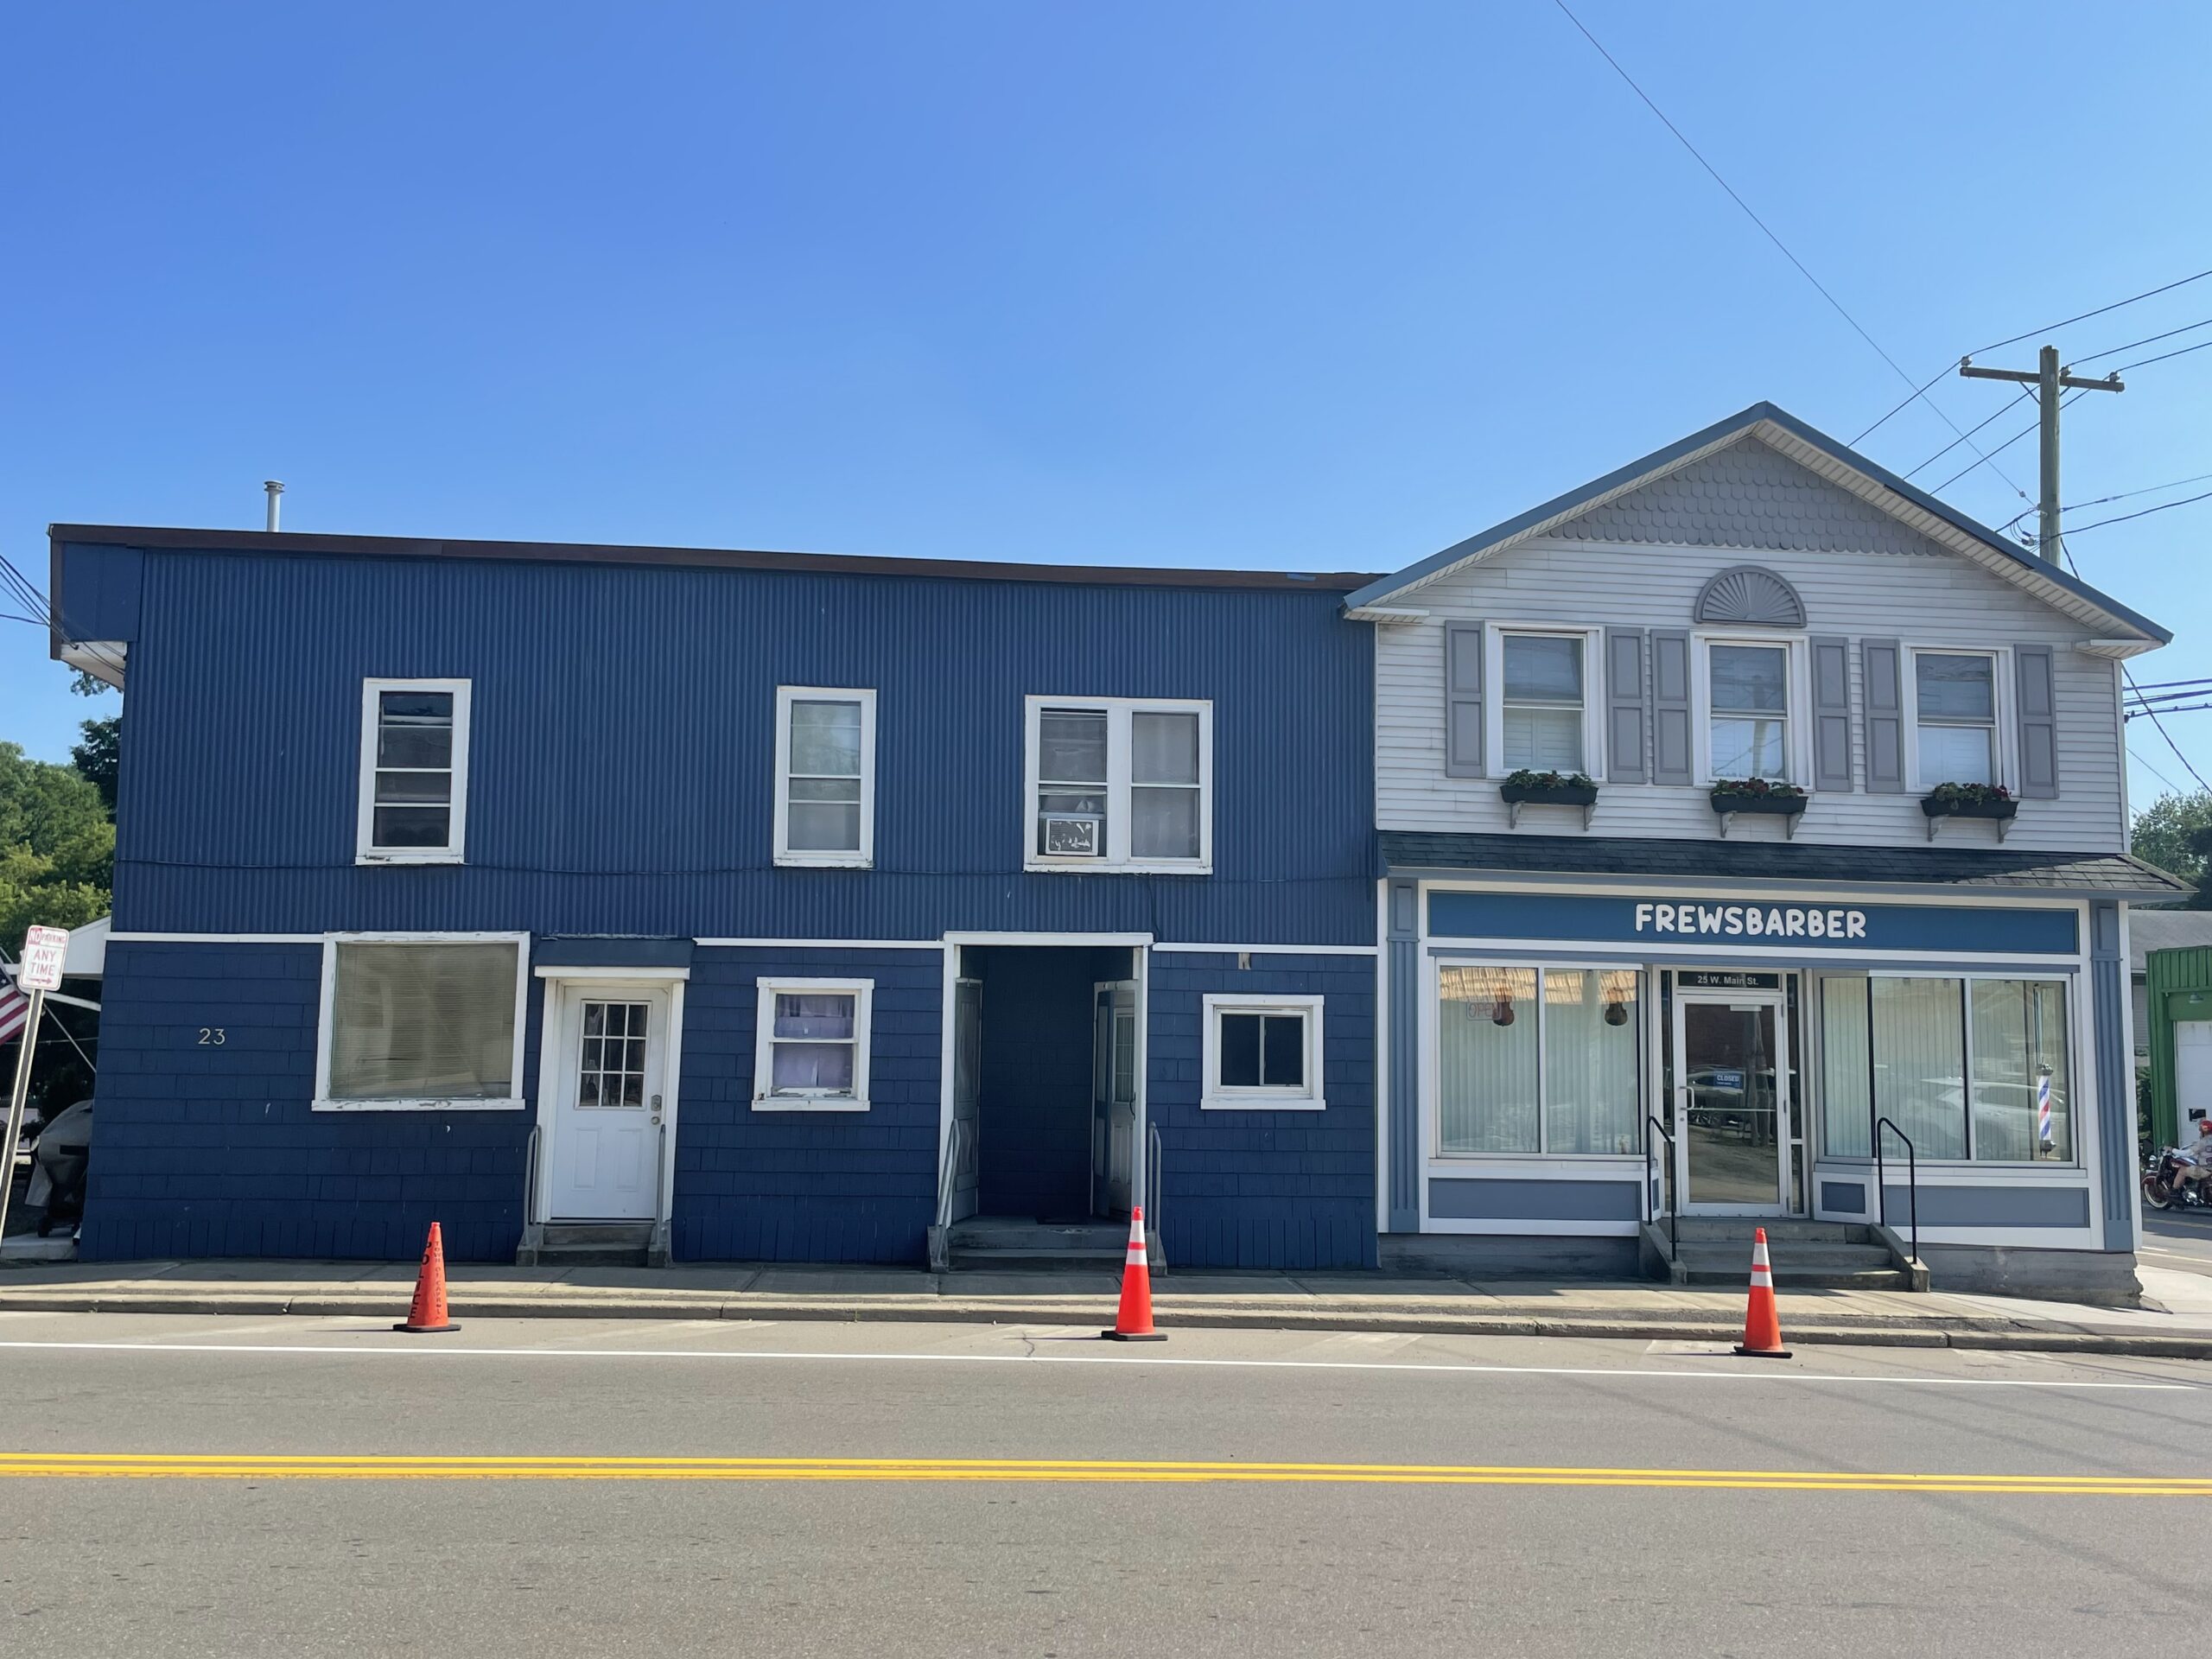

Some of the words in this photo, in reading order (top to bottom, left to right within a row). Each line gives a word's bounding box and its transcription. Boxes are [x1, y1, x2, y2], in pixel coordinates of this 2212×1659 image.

[1635, 903, 1866, 938] FREWSBARBER
[29, 930, 41, 943] NO
[41, 933, 66, 944] PARKING
[34, 950, 56, 962] ANY
[30, 962, 55, 976] TIME
[1697, 975, 1708, 984] 25
[1710, 976, 1721, 985] W.
[1724, 976, 1745, 986] Main
[1747, 976, 1759, 986] St.
[1469, 1003, 1500, 1018] OPEN
[198, 1027, 226, 1045] 23
